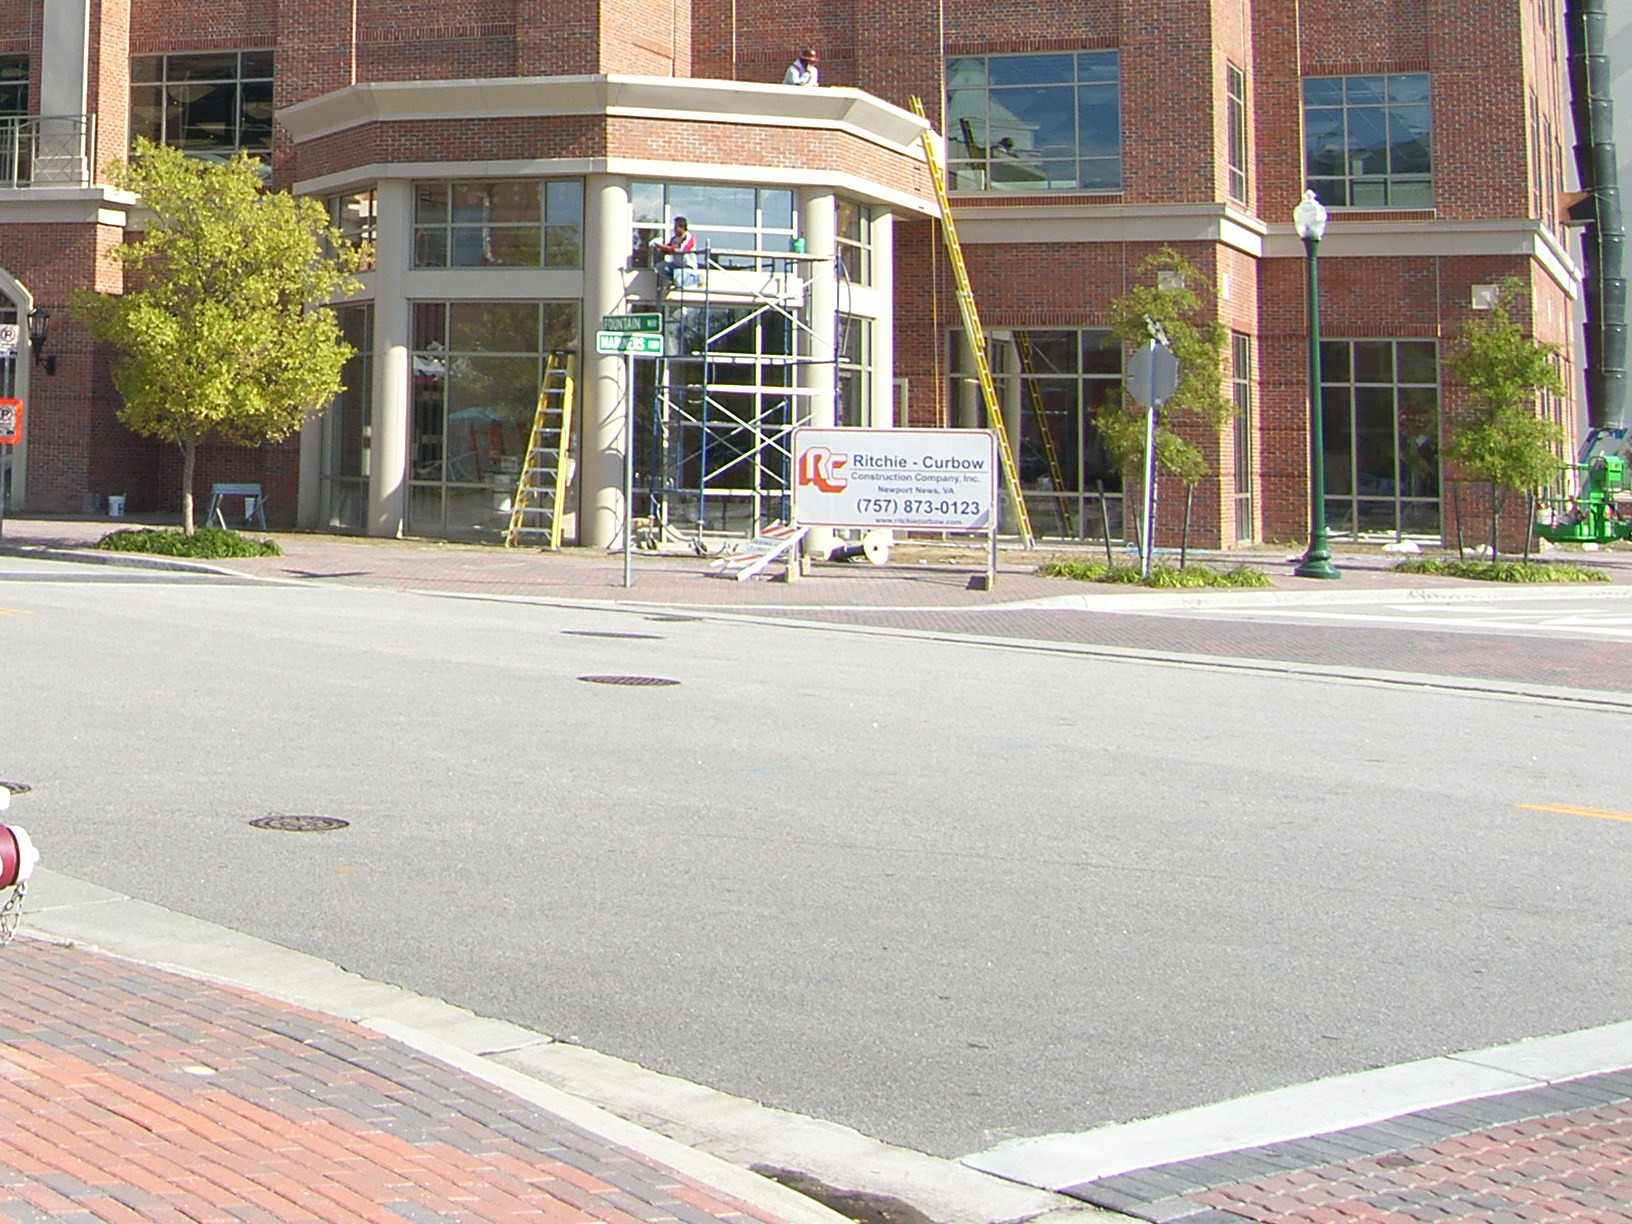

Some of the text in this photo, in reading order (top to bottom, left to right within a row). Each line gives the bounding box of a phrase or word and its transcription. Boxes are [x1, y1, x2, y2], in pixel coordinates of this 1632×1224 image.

[603, 317, 641, 331] FOUNTAIN
[853, 454, 907, 469] Ritchie
[922, 455, 985, 470] Curbow
[850, 471, 913, 482] Construction
[963, 474, 981, 483] Inc.
[877, 485, 913, 495] Newport
[942, 487, 955, 495] VA
[856, 498, 980, 516] (757) 873-0123
